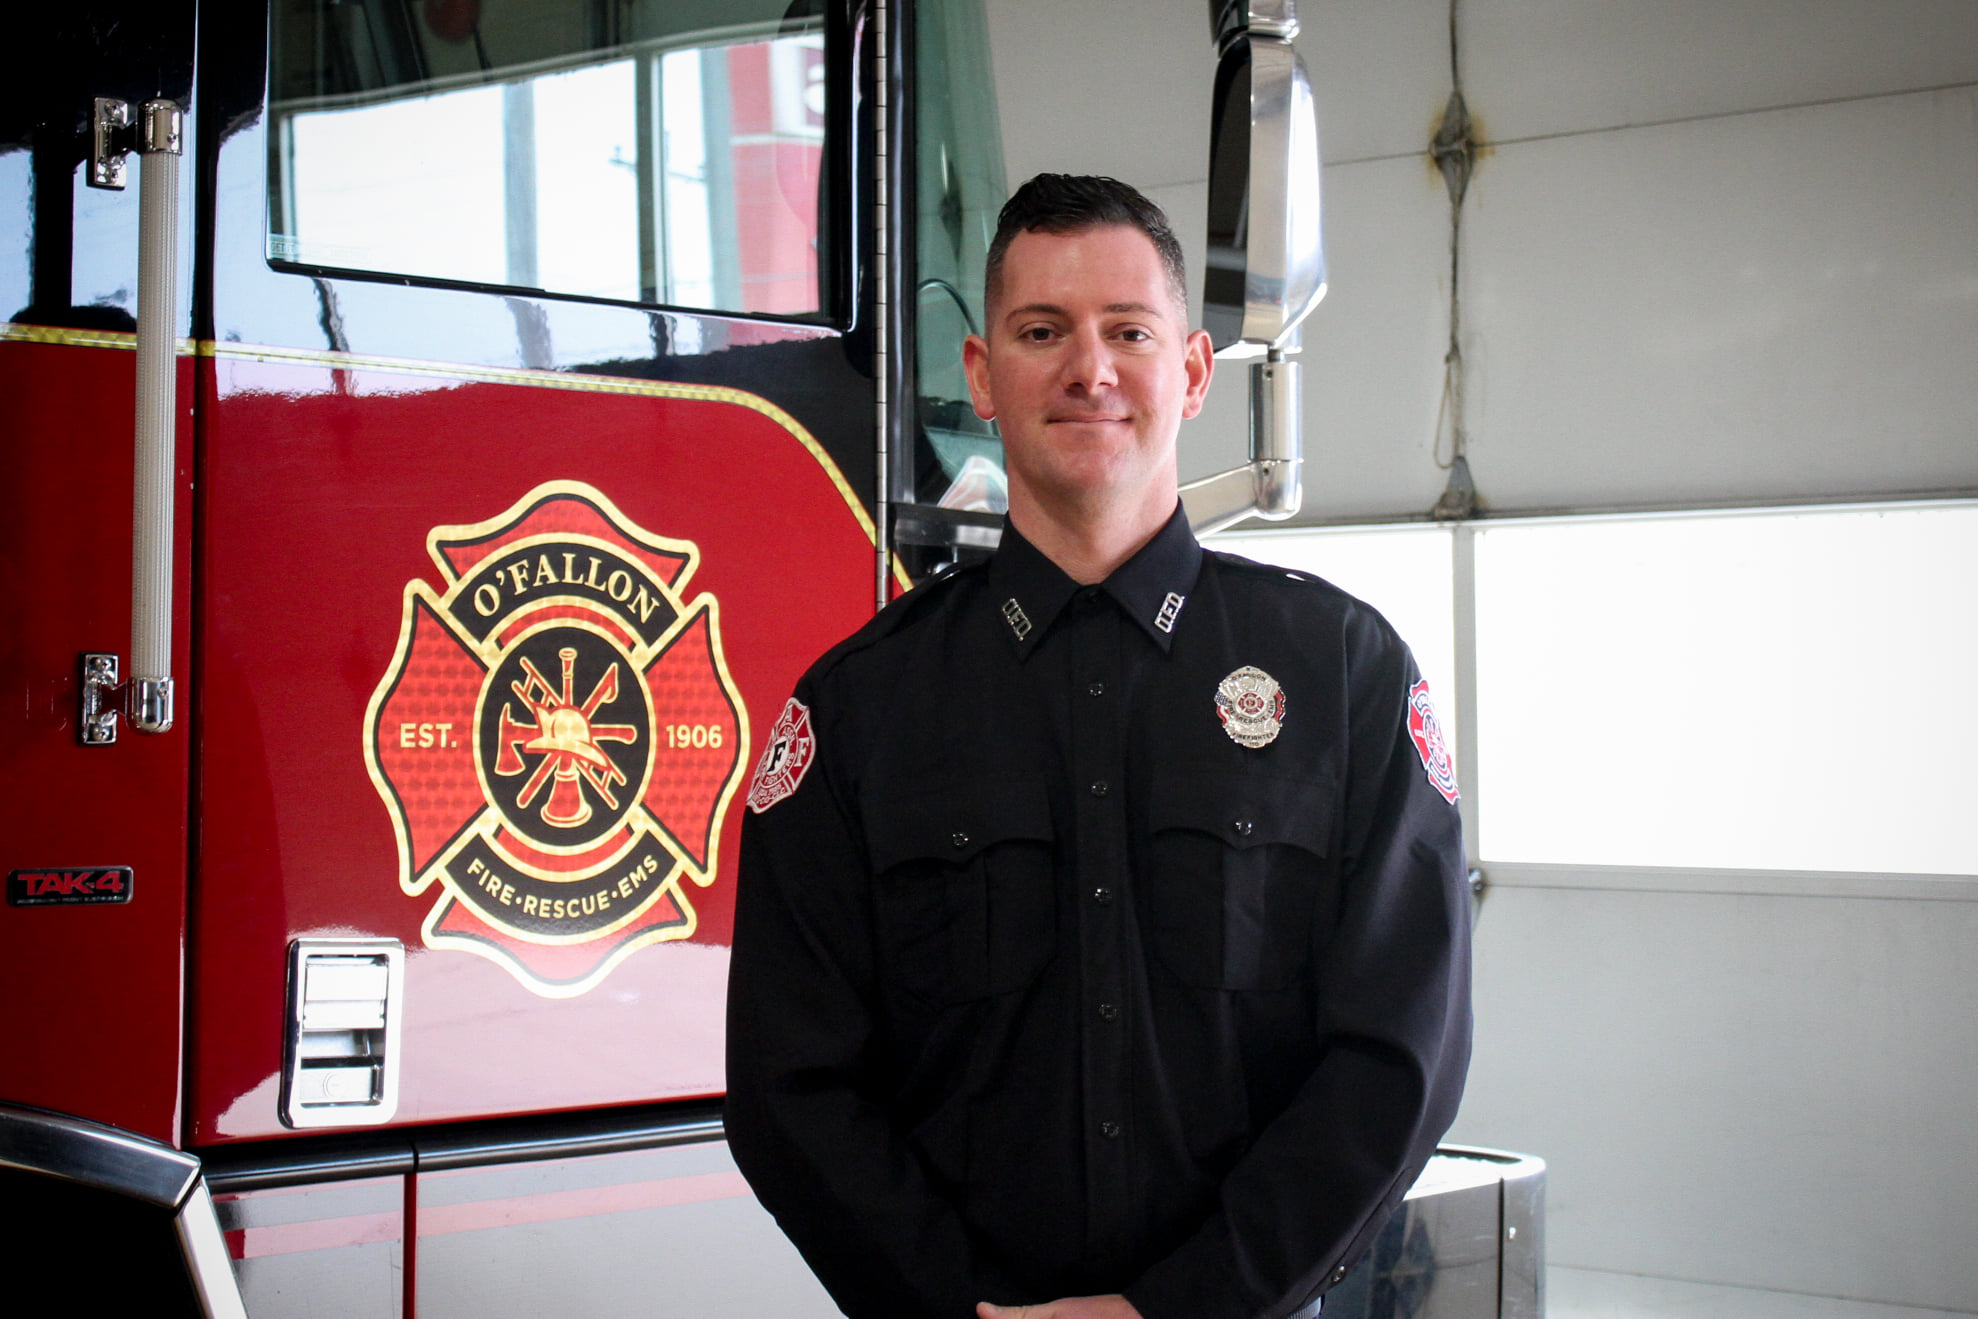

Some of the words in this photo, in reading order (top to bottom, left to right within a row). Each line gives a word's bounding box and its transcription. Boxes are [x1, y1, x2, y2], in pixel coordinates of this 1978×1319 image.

[473, 552, 661, 625] O'FALLON
[400, 722, 458, 749] EST.
[665, 724, 723, 749] 1906
[796, 737, 810, 767] F
[17, 871, 125, 896] TAK-4
